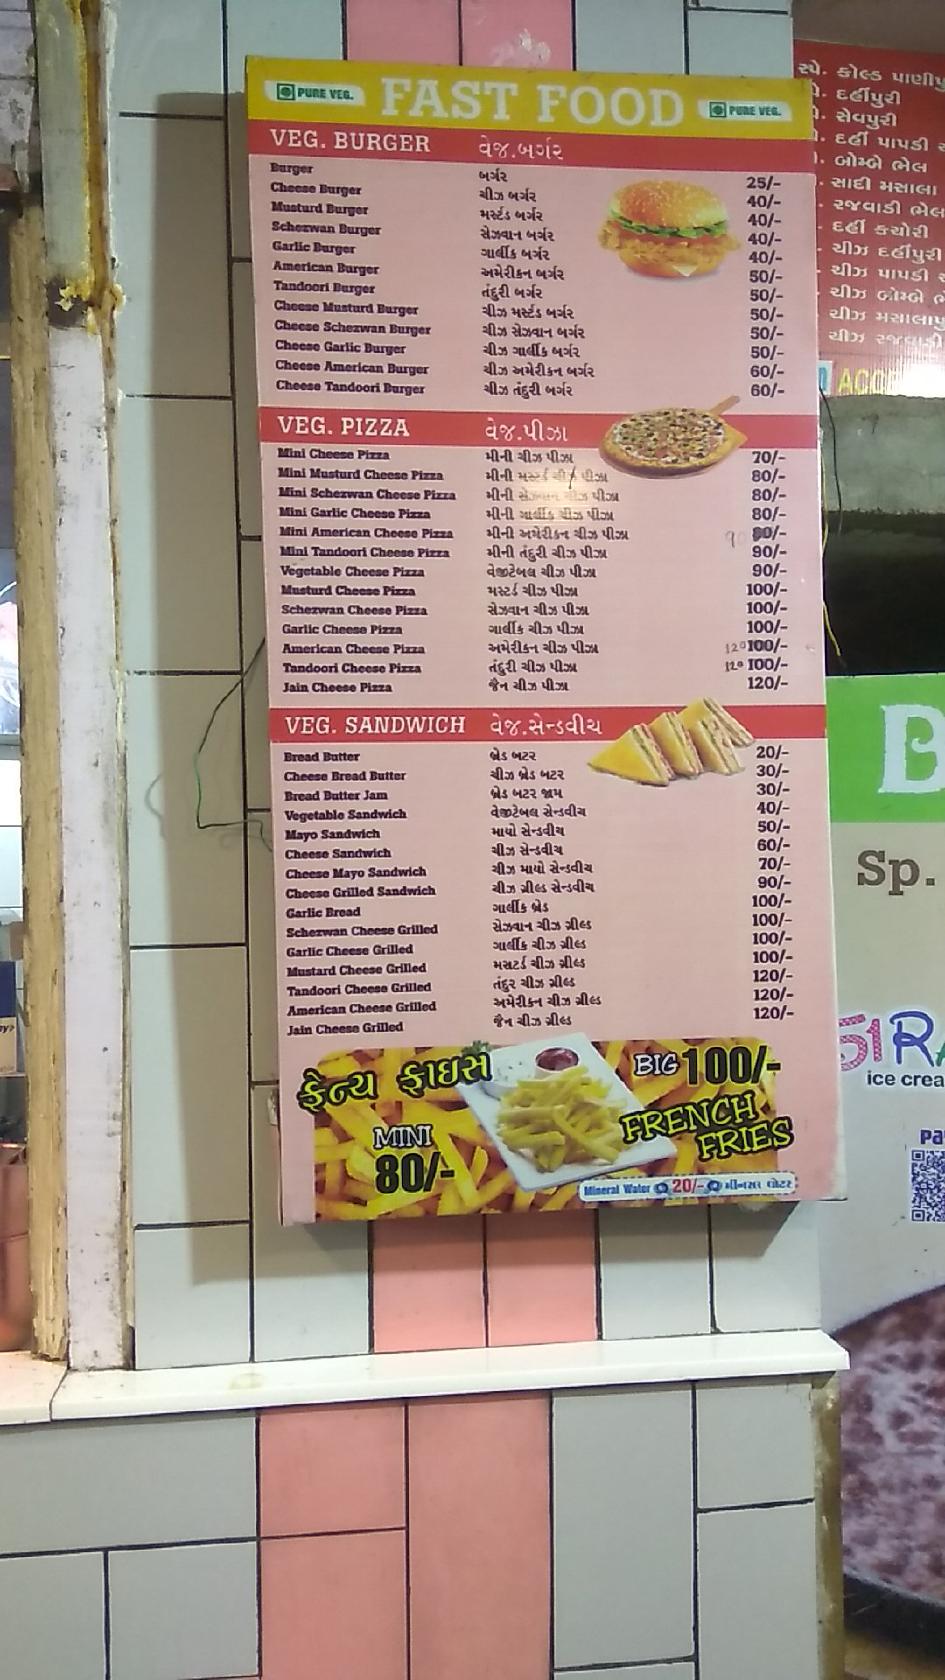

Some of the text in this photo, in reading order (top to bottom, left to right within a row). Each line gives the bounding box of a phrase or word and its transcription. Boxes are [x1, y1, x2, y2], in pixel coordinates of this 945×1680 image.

[297, 87, 354, 100] PURE VEG.
[381, 78, 684, 127] FAST FOOD
[729, 105, 782, 117] PURE VEG.
[270, 129, 431, 152] VEG. BURGER
[270, 163, 313, 176] Burger
[270, 182, 361, 197] Cheese Burger
[747, 176, 781, 190] 25/-
[747, 194, 781, 209] 40/-
[748, 213, 781, 228] 40/-
[748, 232, 781, 247] 40/-
[272, 241, 356, 256] Garlic Burger
[749, 250, 782, 265] 40/-
[273, 261, 379, 276] American Burger
[750, 269, 782, 284] 50/-
[273, 280, 375, 296] Tandoori Burger
[750, 288, 783, 304] 50/-
[751, 382, 784, 398] 60/-
[277, 416, 410, 437] VEG. PIZZA
[278, 448, 390, 460] Mini Cheese Pizza
[752, 448, 786, 465] 70/-
[752, 468, 785, 484] 80/-
[280, 564, 424, 578] Vegetable Cheese Pizza
[753, 563, 787, 578] 90/-
[747, 600, 787, 615] 100/-
[282, 624, 402, 634] Garlic Cheese Pizza
[747, 619, 788, 634] 100/-
[282, 644, 425, 654] American Cheese Pizza
[747, 638, 788, 653] 100/-
[283, 663, 421, 673] Tandoori Cheese Pizza
[747, 657, 788, 672] 100/-
[283, 682, 392, 692] Jain Cheese Pizza
[748, 675, 788, 690] 120/-
[285, 716, 466, 735] VEG. SANDWICH
[284, 752, 360, 762] Bread Butter
[757, 745, 789, 759] 20/-
[284, 771, 406, 781] Cheese Bread Butter
[757, 763, 789, 778] 30/-
[284, 790, 388, 801] Bread Butter Jam
[757, 781, 790, 796] 30/-
[757, 800, 789, 815] 40/-
[284, 809, 407, 823] Vegetable Sandwich
[758, 819, 790, 834] 50/-
[285, 829, 380, 842] Mayo Sandwich
[757, 837, 790, 852] 60/-
[285, 848, 392, 859] Cheese Sandwich
[759, 856, 790, 871] 70/-
[285, 866, 426, 880] Cheese Mayo Sandwich
[857, 849, 936, 896] Sp.
[752, 893, 791, 908] 100/-
[286, 907, 360, 918] Garlic Bread
[753, 949, 793, 964] 100/-
[287, 963, 426, 977] Mustard Cheese Grilled
[754, 1005, 794, 1020] 120/-
[287, 1022, 403, 1036] Jain Cheese Grilled
[634, 1046, 782, 1085] BIG 100/-
[867, 1070, 896, 1086] ice
[622, 1093, 757, 1143] FRENCH
[373, 1125, 432, 1148] MINI
[698, 1118, 793, 1161] FRIES
[376, 1151, 455, 1194] 80/-
[672, 1178, 704, 1194] 20/-
